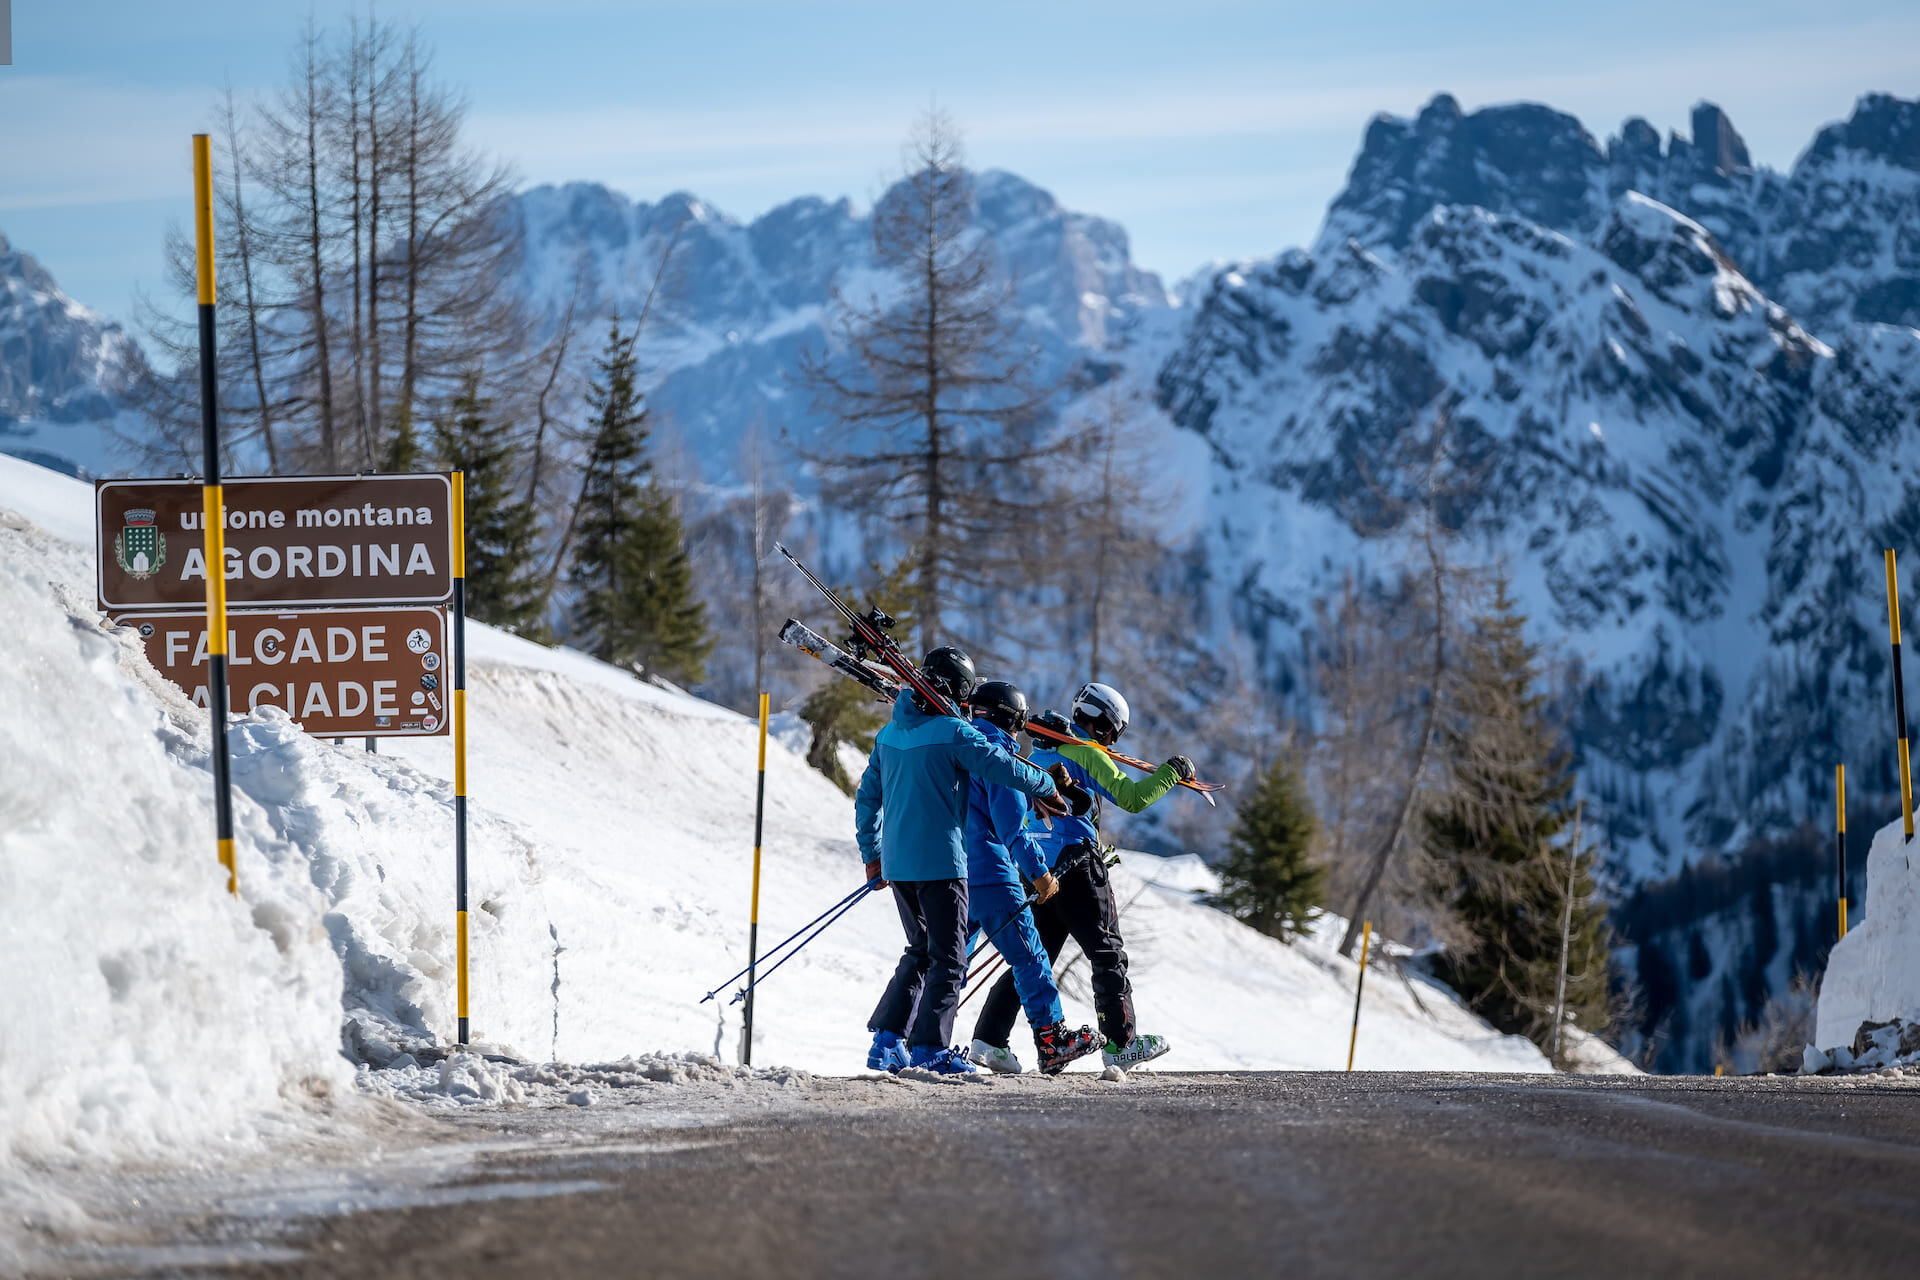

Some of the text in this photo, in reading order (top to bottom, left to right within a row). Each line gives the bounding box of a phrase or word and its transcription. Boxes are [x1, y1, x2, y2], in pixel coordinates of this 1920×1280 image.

[180, 502, 433, 530] uione montana
[180, 542, 436, 581] AGORDINA
